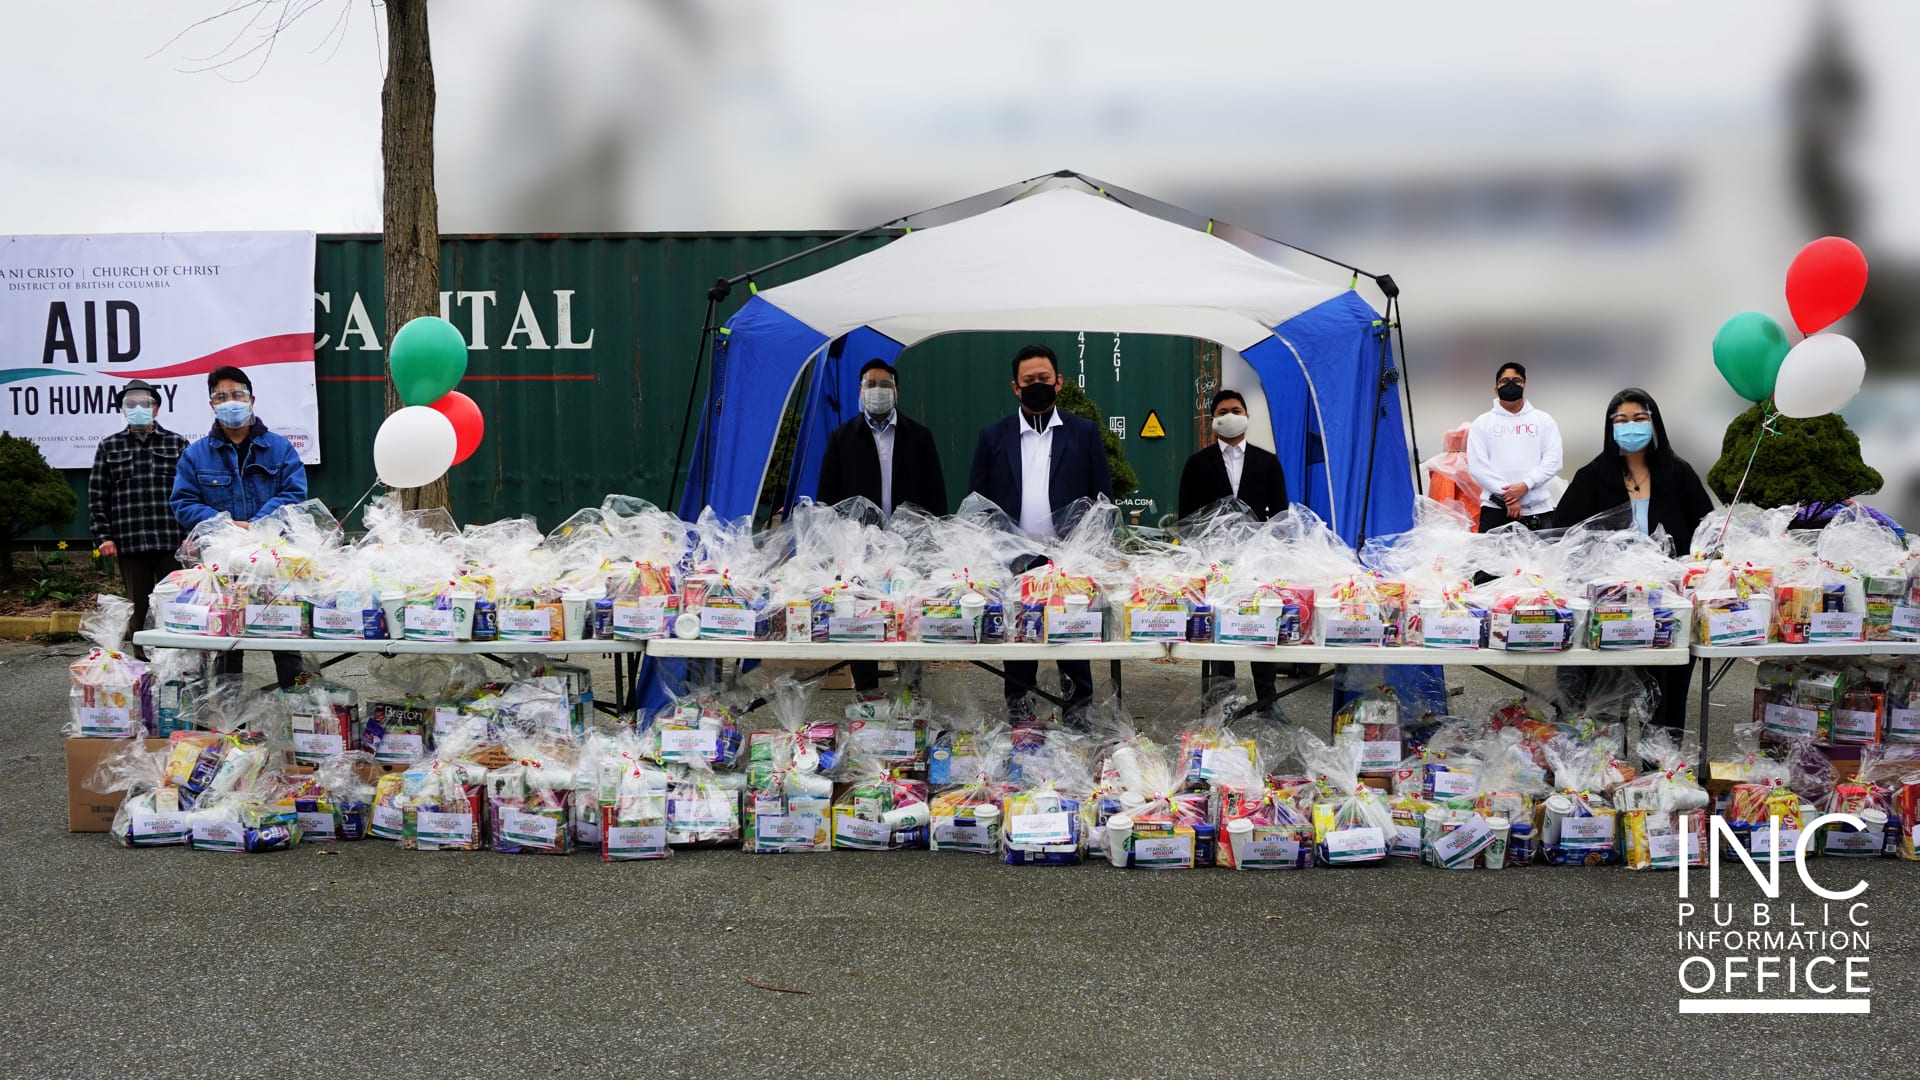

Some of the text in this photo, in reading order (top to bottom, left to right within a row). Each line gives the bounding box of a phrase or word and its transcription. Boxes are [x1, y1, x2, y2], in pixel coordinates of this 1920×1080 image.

[10, 268, 23, 278] NI
[27, 267, 74, 278] CRISTO
[92, 266, 149, 277] CHURCH
[153, 266, 170, 276] OF
[173, 265, 220, 276] CHRIST
[9, 281, 170, 291] DISTRICT OF BRITISH COLUMBIA
[42, 300, 141, 363] AID
[9, 386, 39, 415] TO
[1493, 424, 1538, 437] giving
[1134, 498, 1153, 506] CGM
[385, 706, 423, 721] Breton
